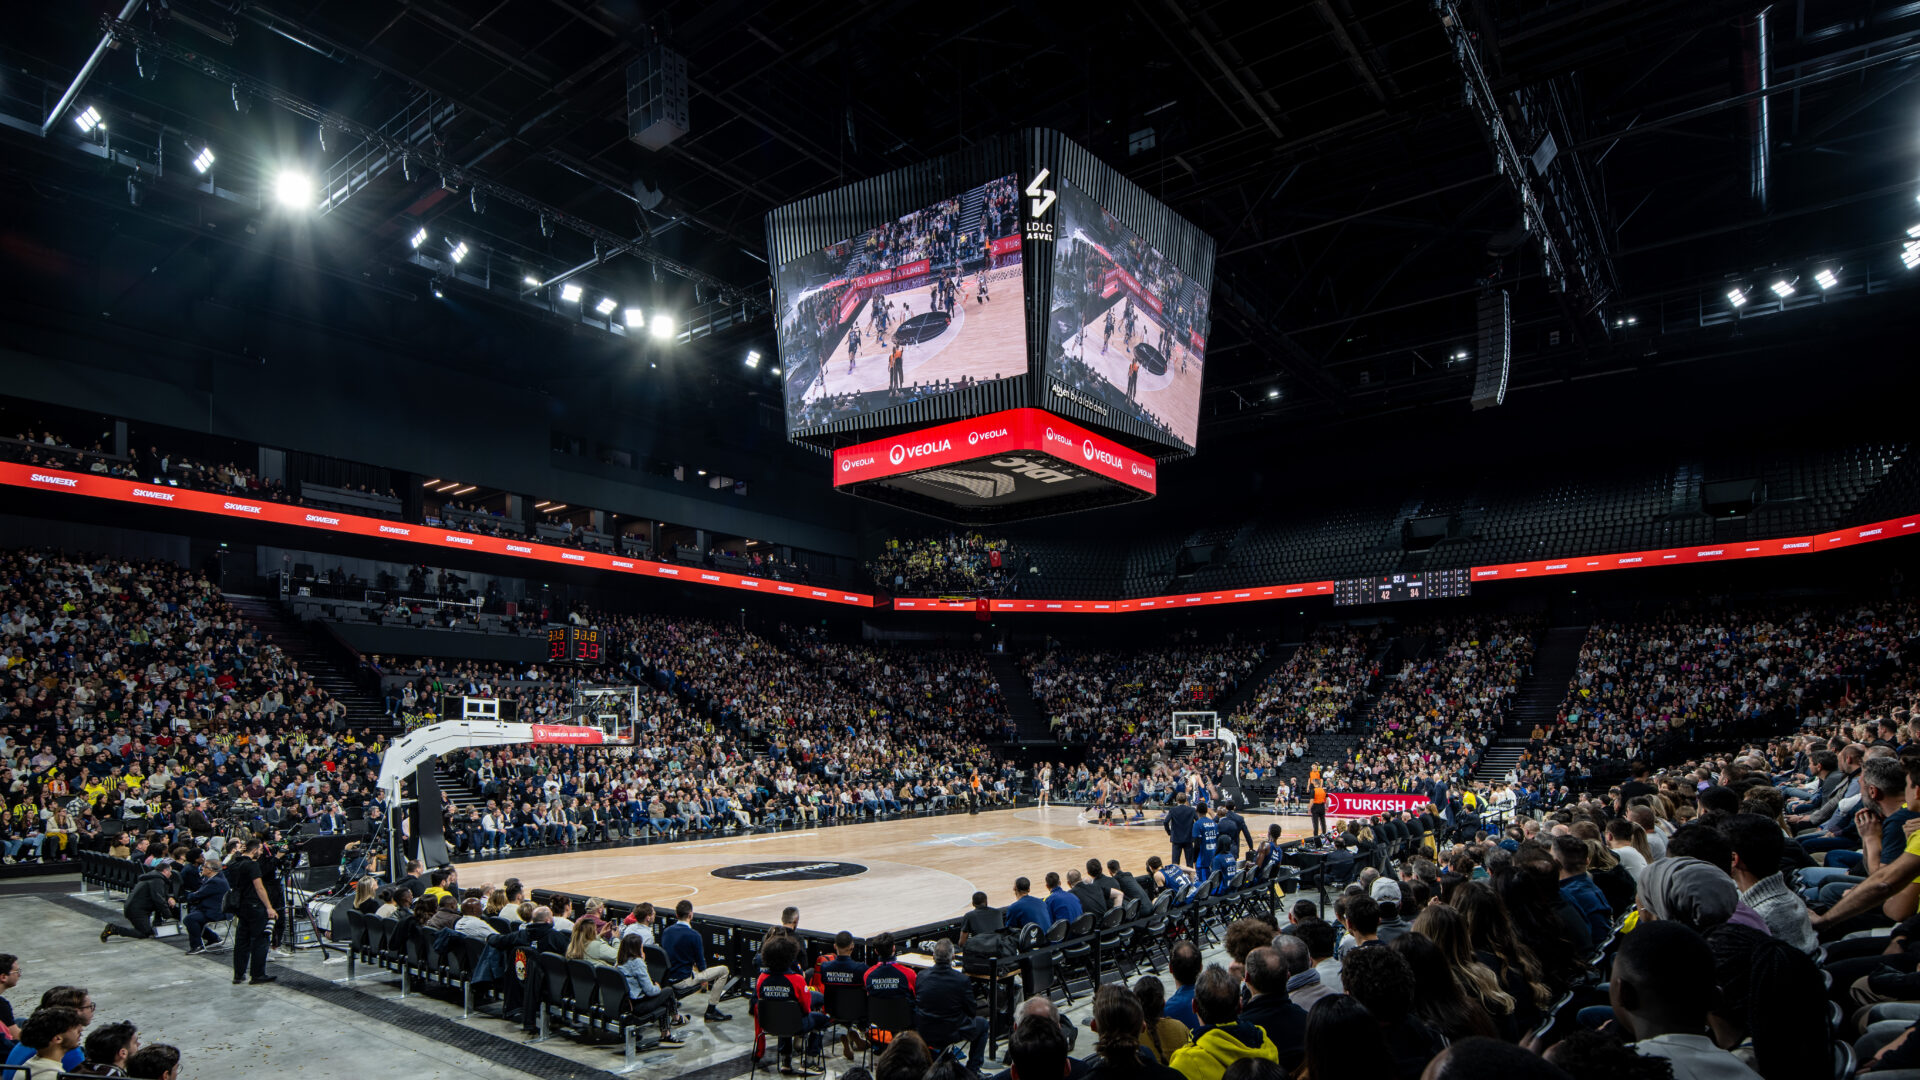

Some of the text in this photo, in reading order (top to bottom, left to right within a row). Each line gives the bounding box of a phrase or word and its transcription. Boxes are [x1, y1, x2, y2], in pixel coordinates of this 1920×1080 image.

[1026, 222, 1053, 233] LDLC
[1026, 232, 1053, 242] ASVEL
[1070, 393, 1078, 403] by
[1078, 397, 1107, 416] alabama
[980, 428, 1007, 441] VEOLIA
[1054, 433, 1073, 447] VEOLIA
[907, 439, 951, 458] VEOLIA
[851, 457, 875, 468] VEOLIA
[1094, 447, 1123, 470] VEOLIA
[1137, 466, 1153, 479] VEOLIA
[30, 473, 78, 487] SKWEEK
[132, 488, 175, 501] SKWEEK
[224, 502, 262, 514] SKWEEK
[306, 514, 340, 526] SKWEEK
[379, 525, 410, 536] SKWEEK
[445, 535, 474, 545] SKWEEK
[1381, 590, 1390, 600] 42
[1410, 588, 1419, 598] 34
[404, 745, 428, 764] SPALDING
[1343, 798, 1406, 812] TURKISH
[871, 977, 900, 985] PREMIERS
